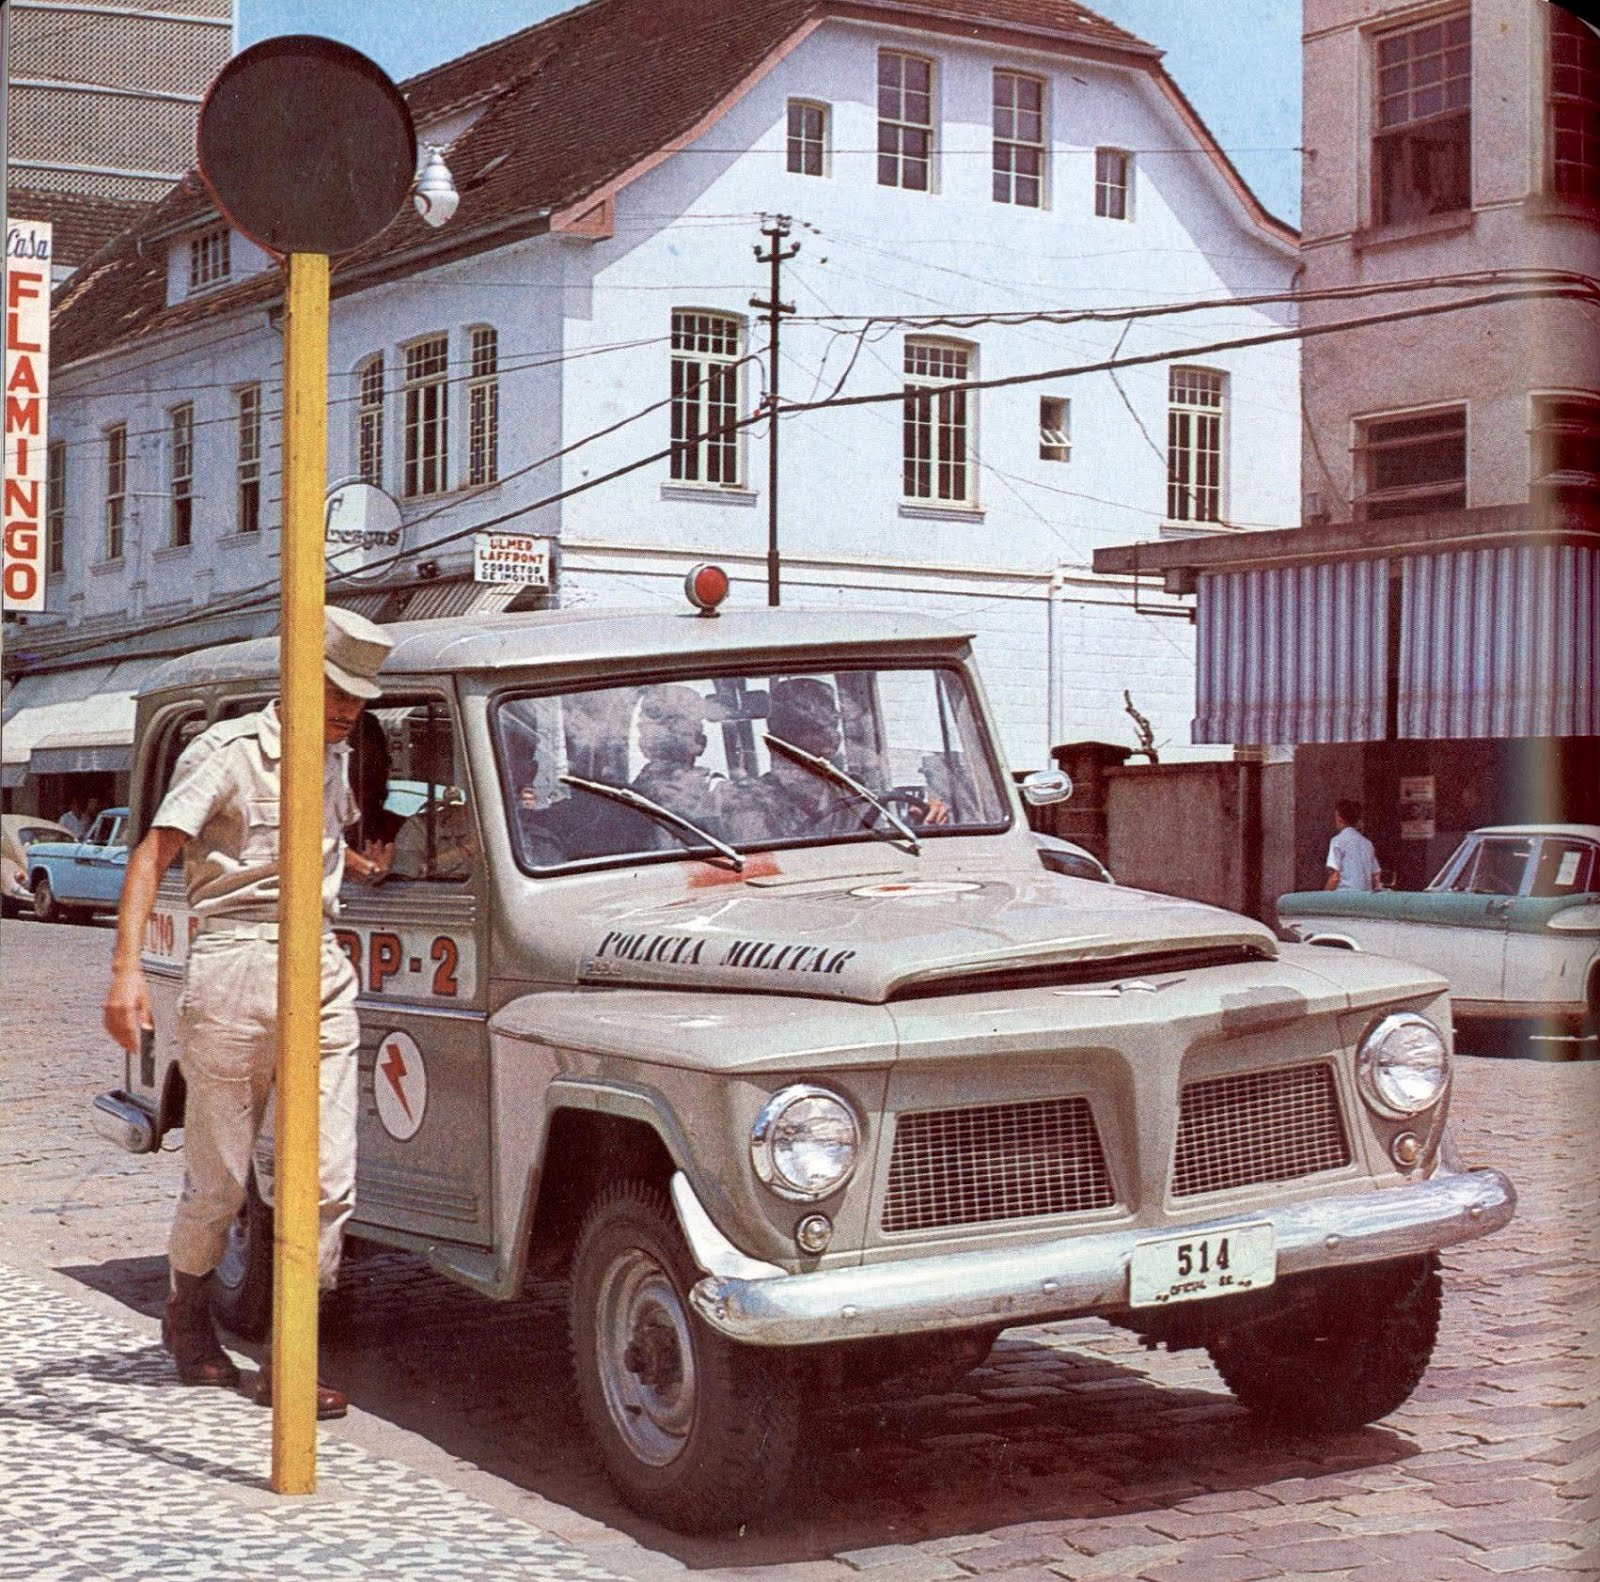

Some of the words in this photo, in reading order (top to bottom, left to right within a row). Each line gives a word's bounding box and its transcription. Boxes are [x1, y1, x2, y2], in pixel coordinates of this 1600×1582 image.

[6, 228, 49, 260] Casa
[4, 270, 43, 600] FLAMINGO
[480, 549, 544, 564] LAFFRONT
[482, 562, 541, 574] CORRETOR
[481, 571, 496, 580] DE
[595, 931, 706, 965] POLICIA
[718, 939, 857, 975] MILITAR
[1177, 1237, 1231, 1277] 514
